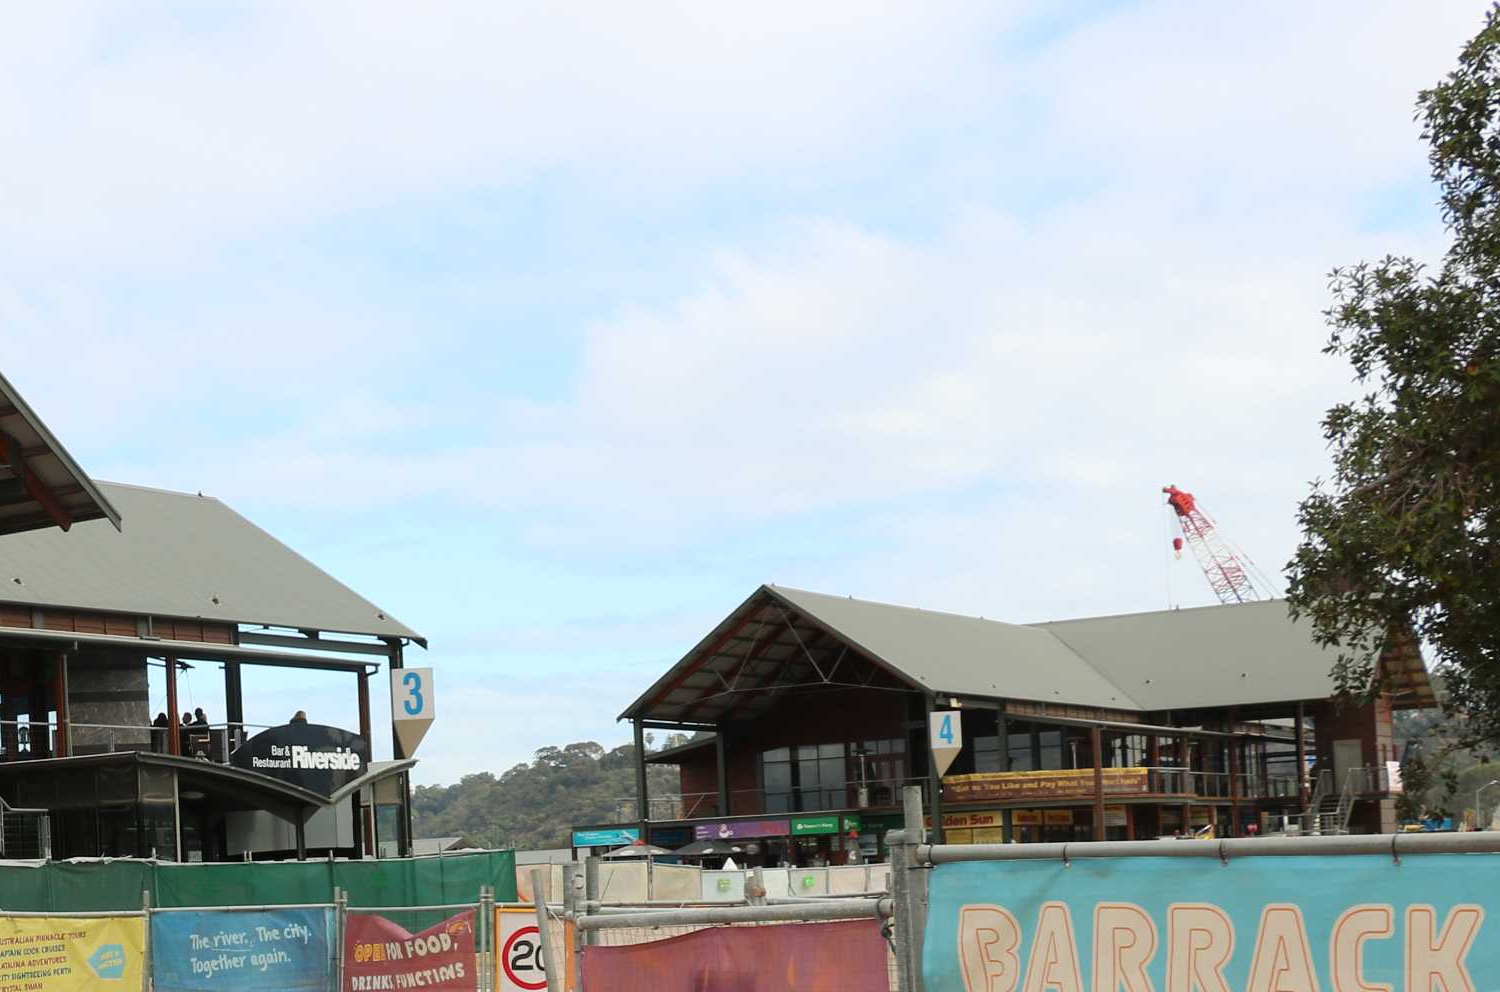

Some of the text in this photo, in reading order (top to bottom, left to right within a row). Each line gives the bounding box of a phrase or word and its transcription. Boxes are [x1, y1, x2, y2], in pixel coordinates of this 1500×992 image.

[403, 672, 423, 715] 3
[939, 714, 954, 745] 4
[271, 745, 290, 756] Bar &
[292, 745, 360, 770] Riverside
[252, 756, 292, 768] Restaurant
[1002, 782, 1021, 790] Like
[1022, 781, 1038, 789] and
[970, 814, 994, 826] Sun
[190, 922, 312, 950] The river. The city.
[404, 932, 459, 958] FOOD,
[23, 947, 40, 955] COOK
[28, 956, 67, 967] ADVENTURES
[190, 948, 291, 979] Together again.
